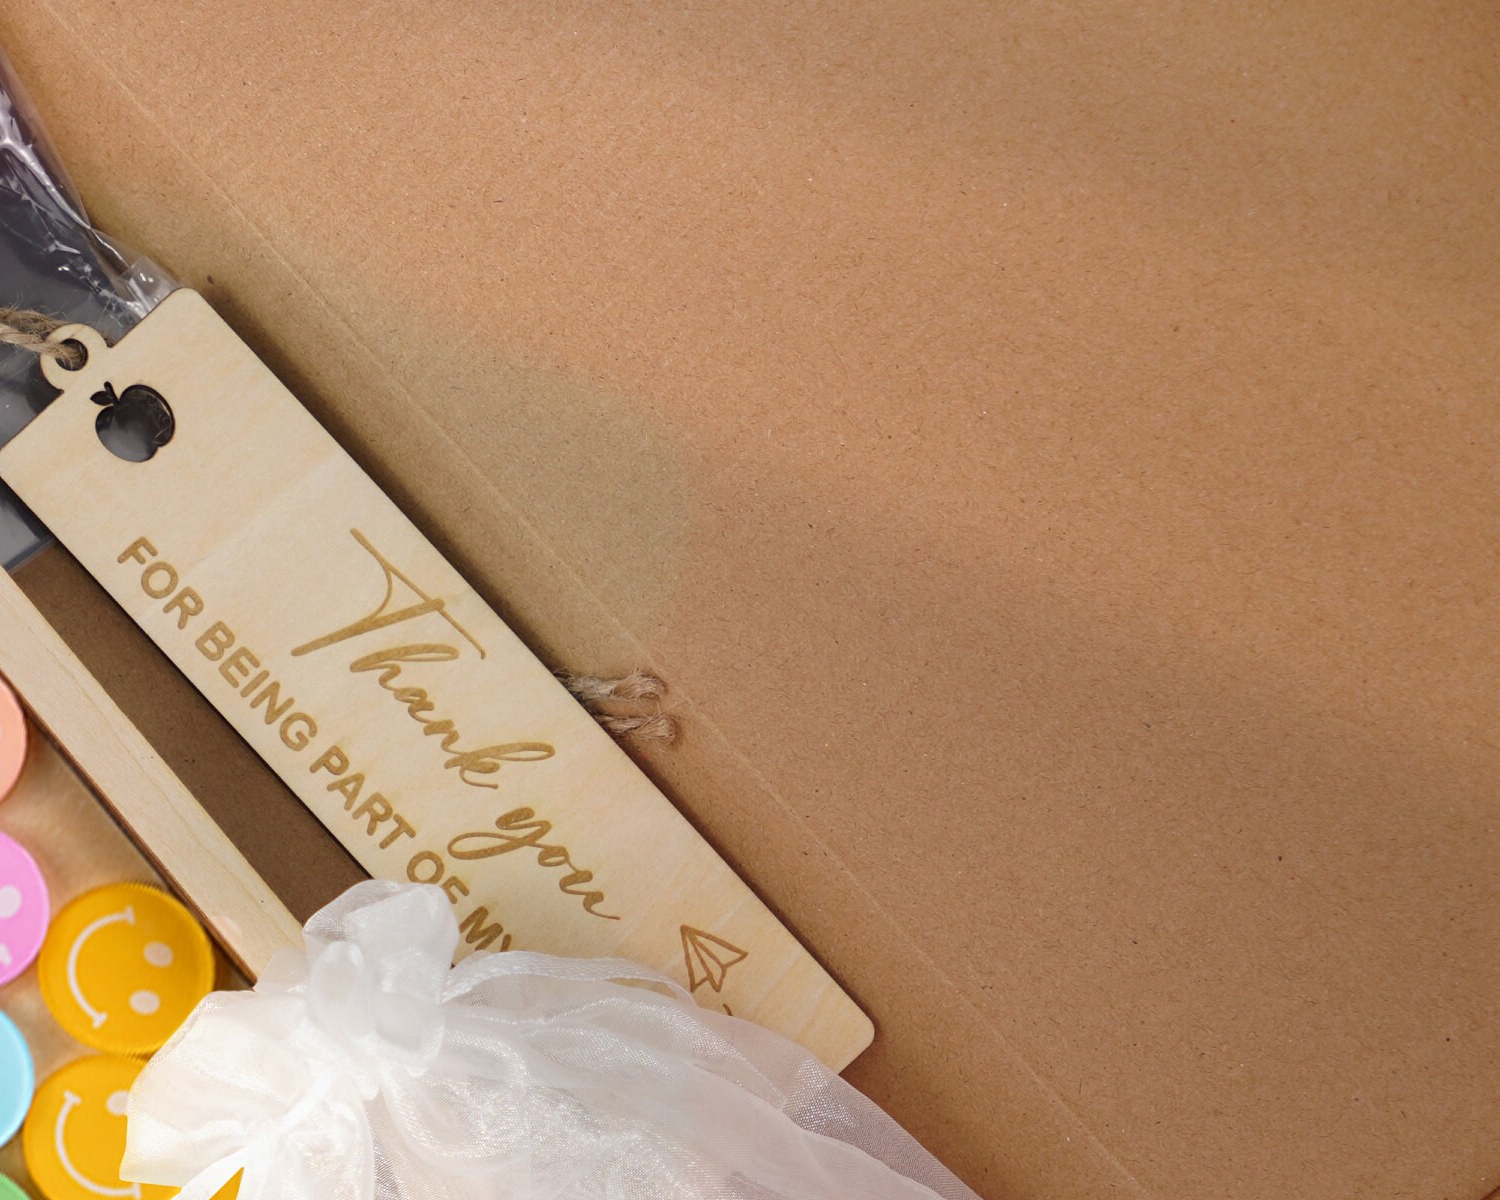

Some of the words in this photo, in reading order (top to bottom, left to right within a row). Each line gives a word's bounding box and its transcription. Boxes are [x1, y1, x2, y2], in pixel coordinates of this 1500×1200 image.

[116, 536, 205, 630] FOR
[194, 620, 318, 752] BEING
[309, 745, 417, 850] PART
[406, 850, 470, 905] OF
[291, 527, 556, 790] Thank
[448, 807, 621, 921] you
